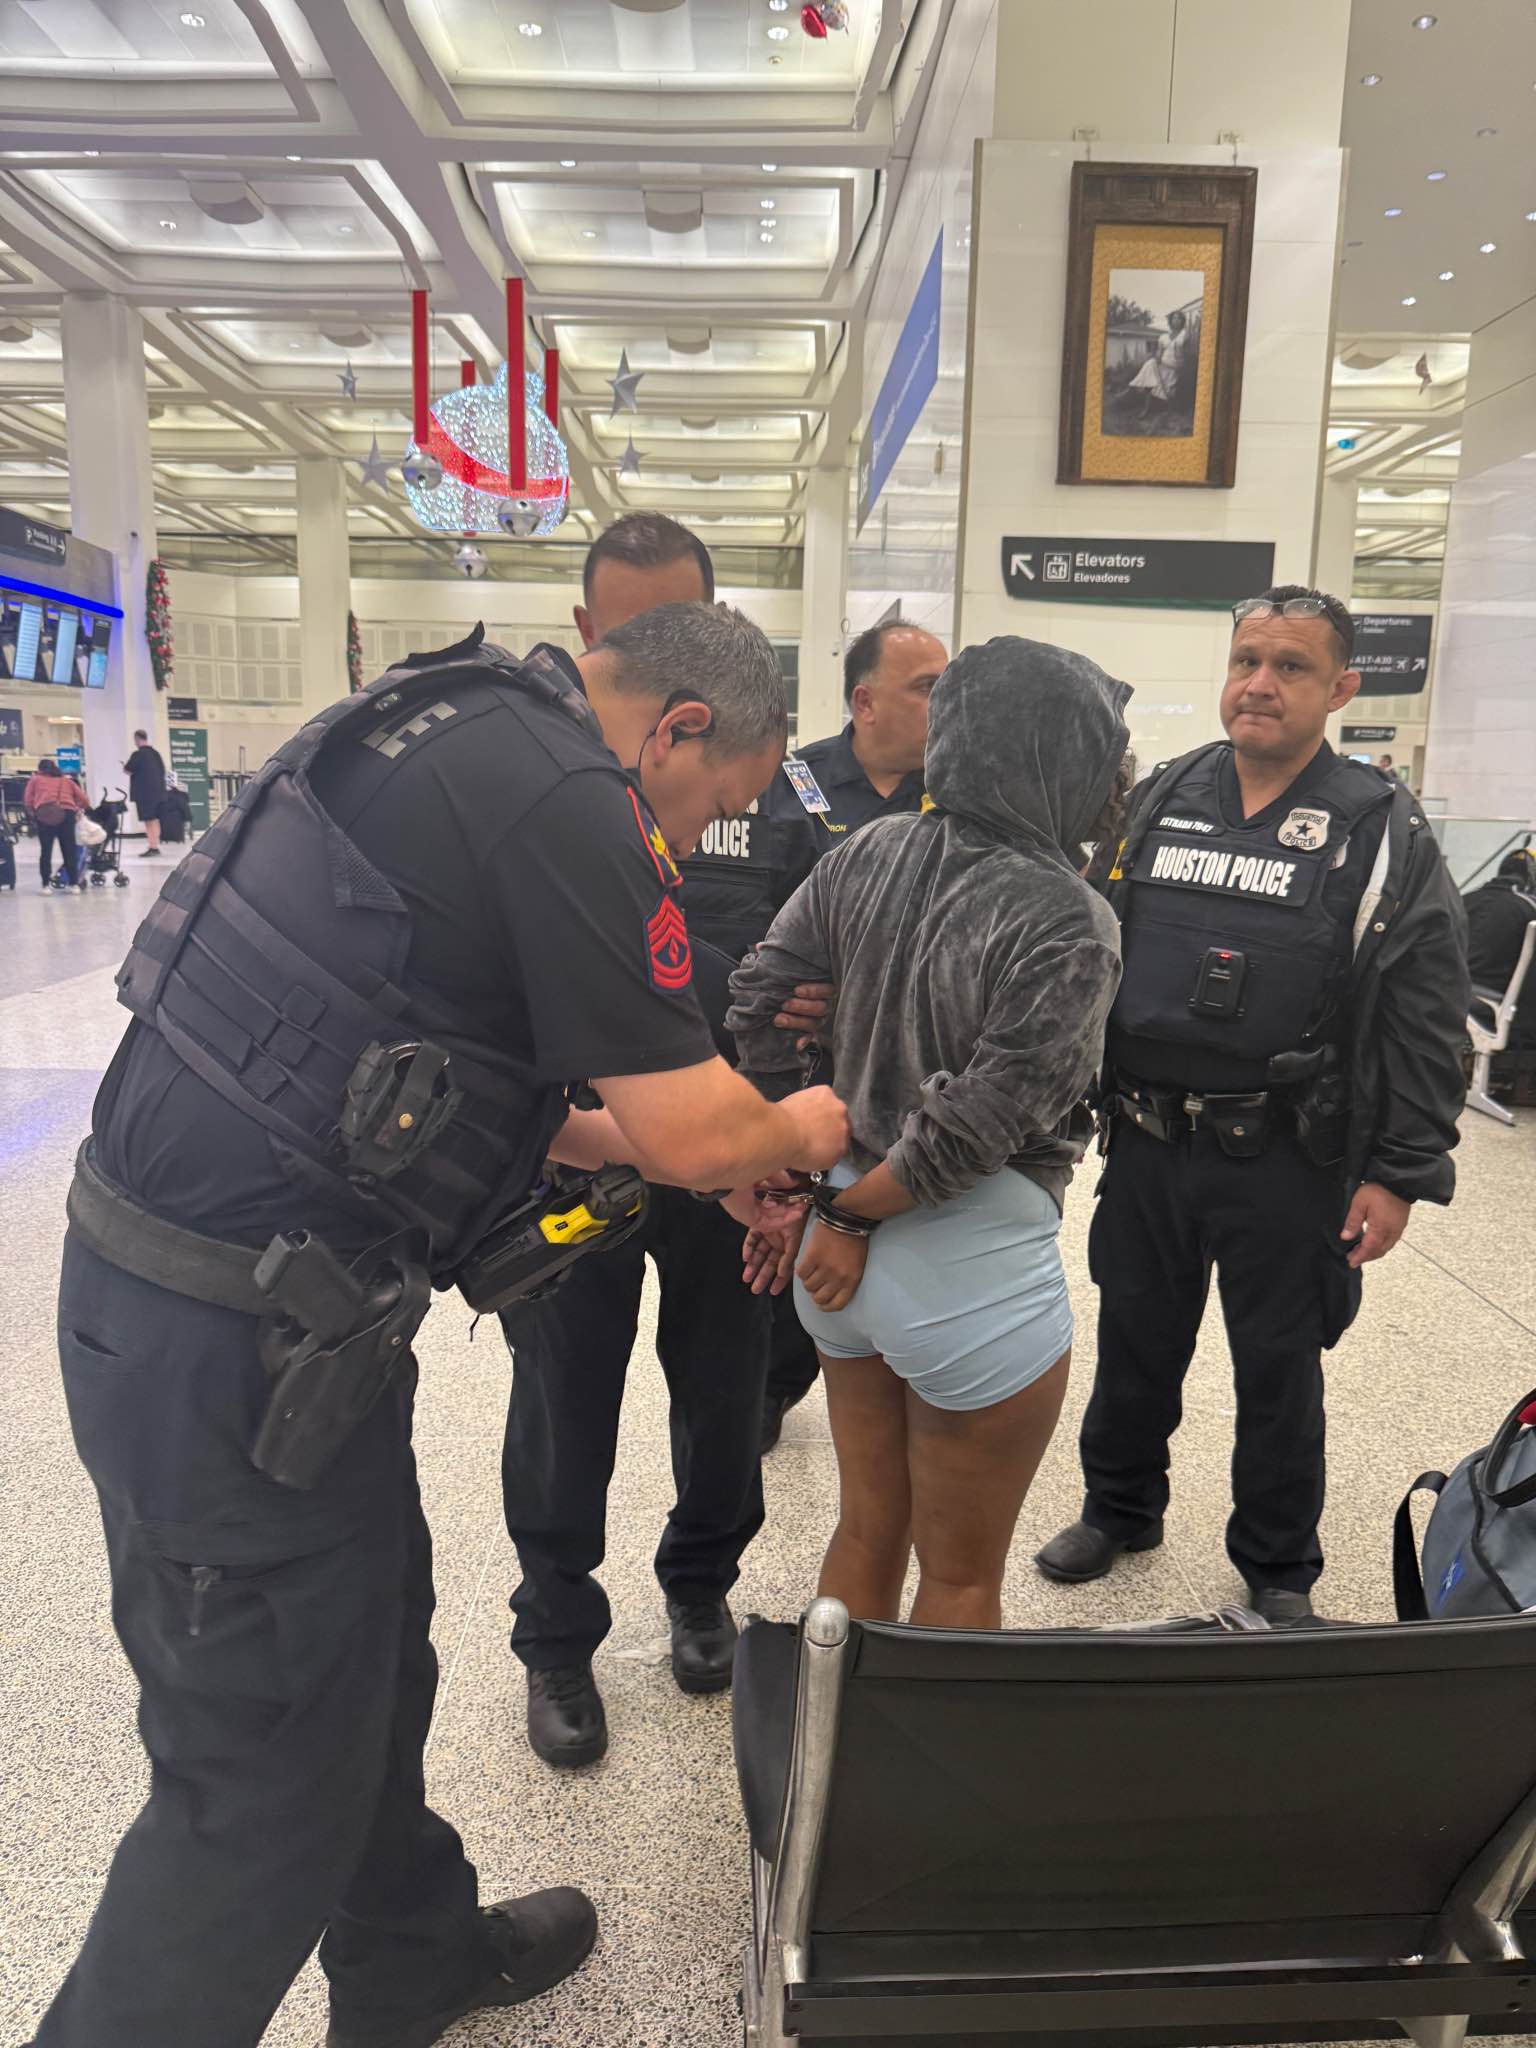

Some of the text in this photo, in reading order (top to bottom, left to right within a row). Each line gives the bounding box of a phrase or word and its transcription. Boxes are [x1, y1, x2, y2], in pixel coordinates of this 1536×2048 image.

[1075, 552, 1146, 568] Elevators
[1073, 572, 1131, 584] Elevadores
[693, 818, 751, 858] OLICE
[1150, 846, 1297, 898] HOUSTON POLICE
